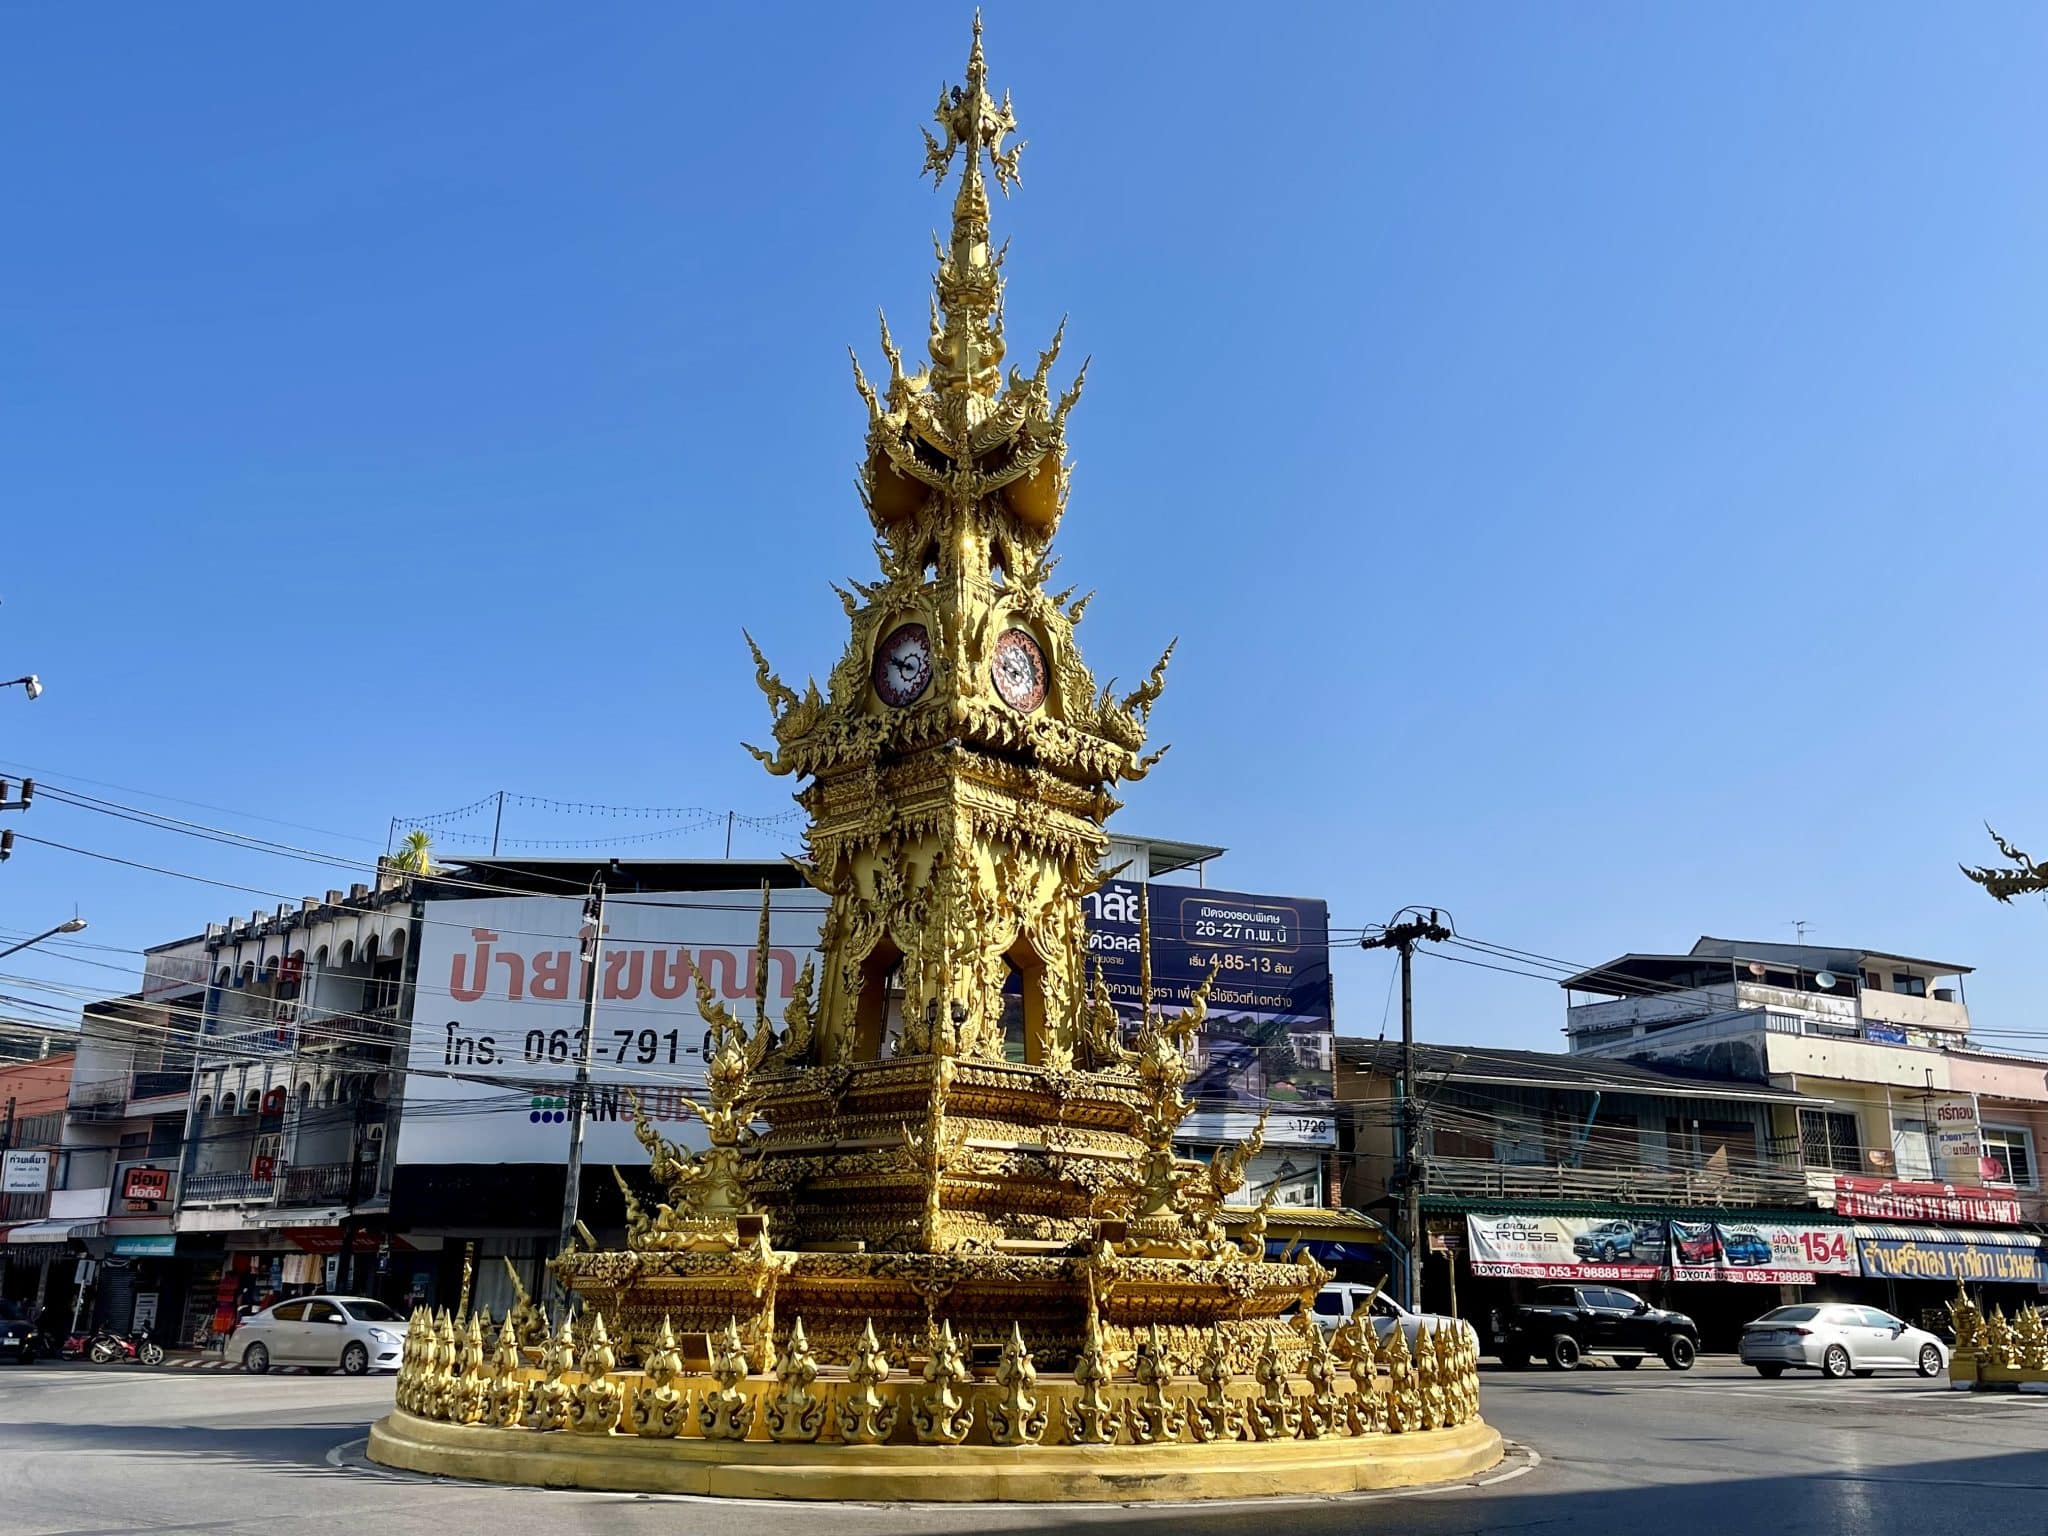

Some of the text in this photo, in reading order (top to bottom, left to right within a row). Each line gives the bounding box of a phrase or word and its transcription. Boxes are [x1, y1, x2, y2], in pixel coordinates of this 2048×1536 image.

[1201, 907, 1280, 924] เปิดจองรอบพิเศษ
[1196, 921, 1242, 939] 26-27
[1245, 928, 1275, 942] ก.พ.
[449, 926, 797, 1002] ป้ายโฆษณา
[1189, 954, 1206, 967] เริ่ม
[445, 1021, 504, 1066] โทร.
[1937, 1102, 1974, 1120] ศรีทอง
[1297, 1119, 1326, 1133] 1720
[131, 1171, 164, 1186] ซ่อม
[129, 1185, 162, 1198] มือถือ
[1481, 1230, 1559, 1242] CROSS
[1799, 1232, 1849, 1263] 154
[1864, 1240, 1947, 1276] ร้านศรีทอง
[1473, 1264, 1512, 1275] TOYOTA
[1549, 1265, 1619, 1279] 053-798888
[1676, 1270, 1711, 1280] TOYOTA
